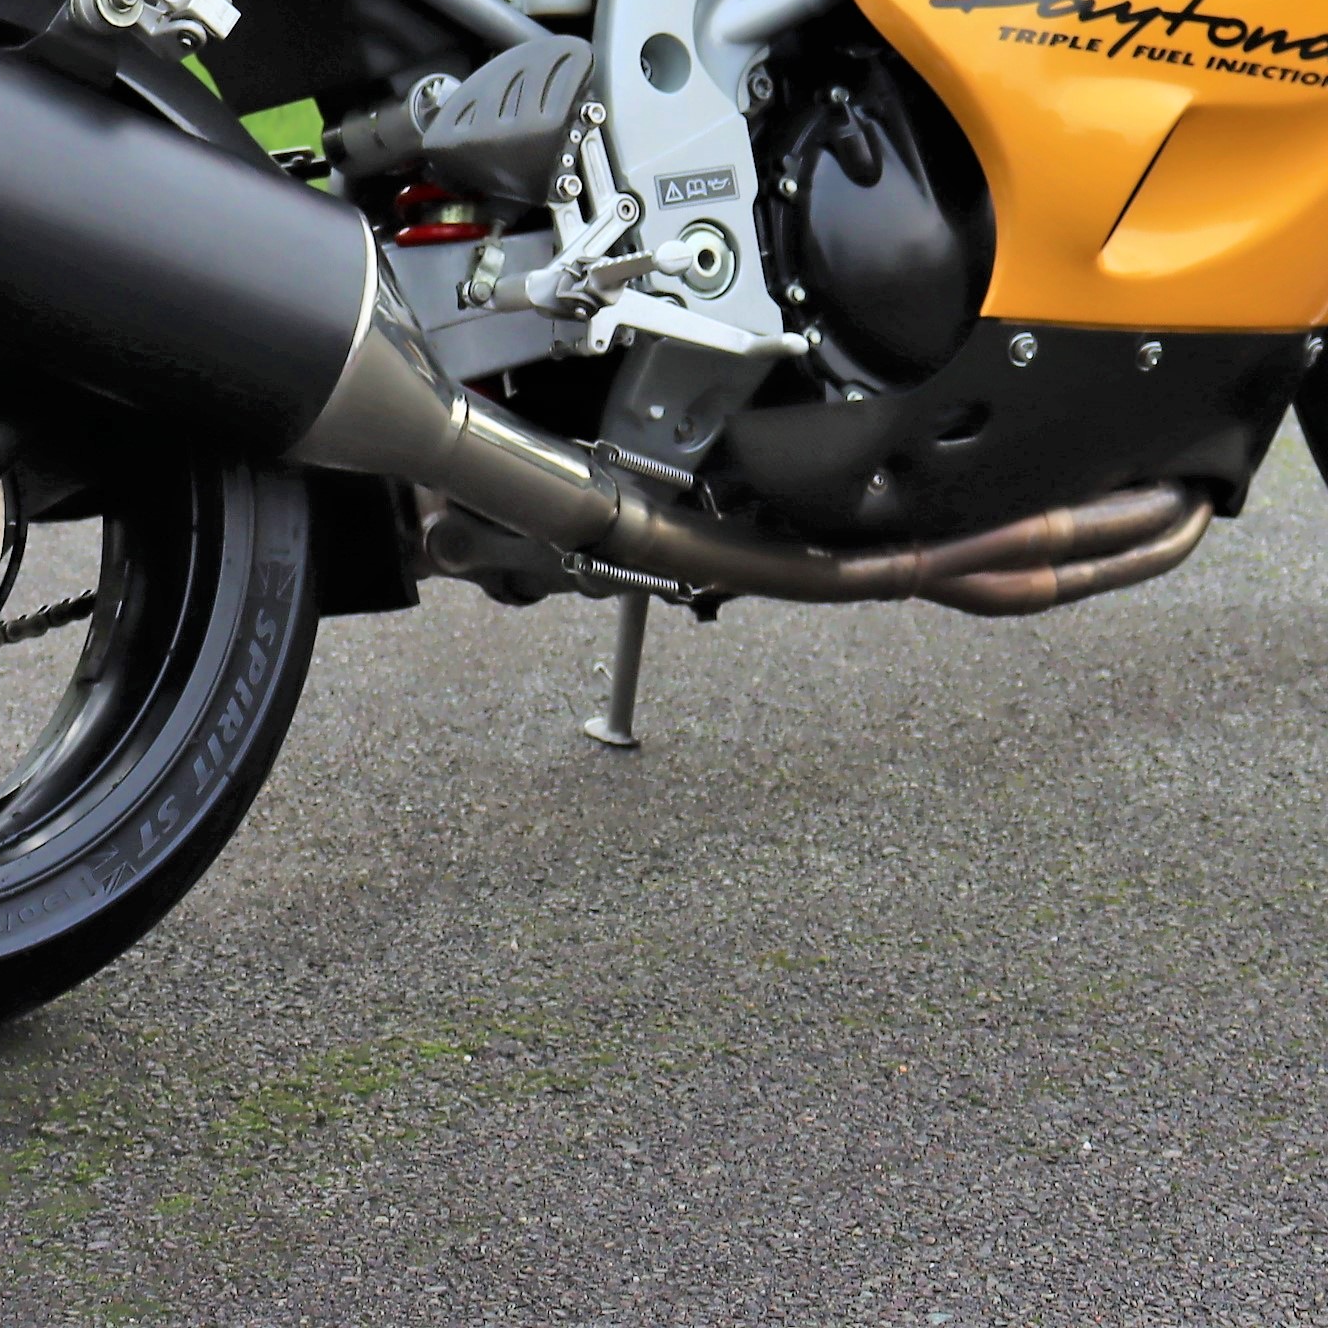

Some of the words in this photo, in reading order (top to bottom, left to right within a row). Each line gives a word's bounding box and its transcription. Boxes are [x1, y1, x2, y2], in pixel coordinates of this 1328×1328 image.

[998, 25, 1104, 53] TRIPLE
[1132, 44, 1195, 67] FUEL
[192, 608, 277, 796] SPIRIT
[137, 794, 181, 859] ST
